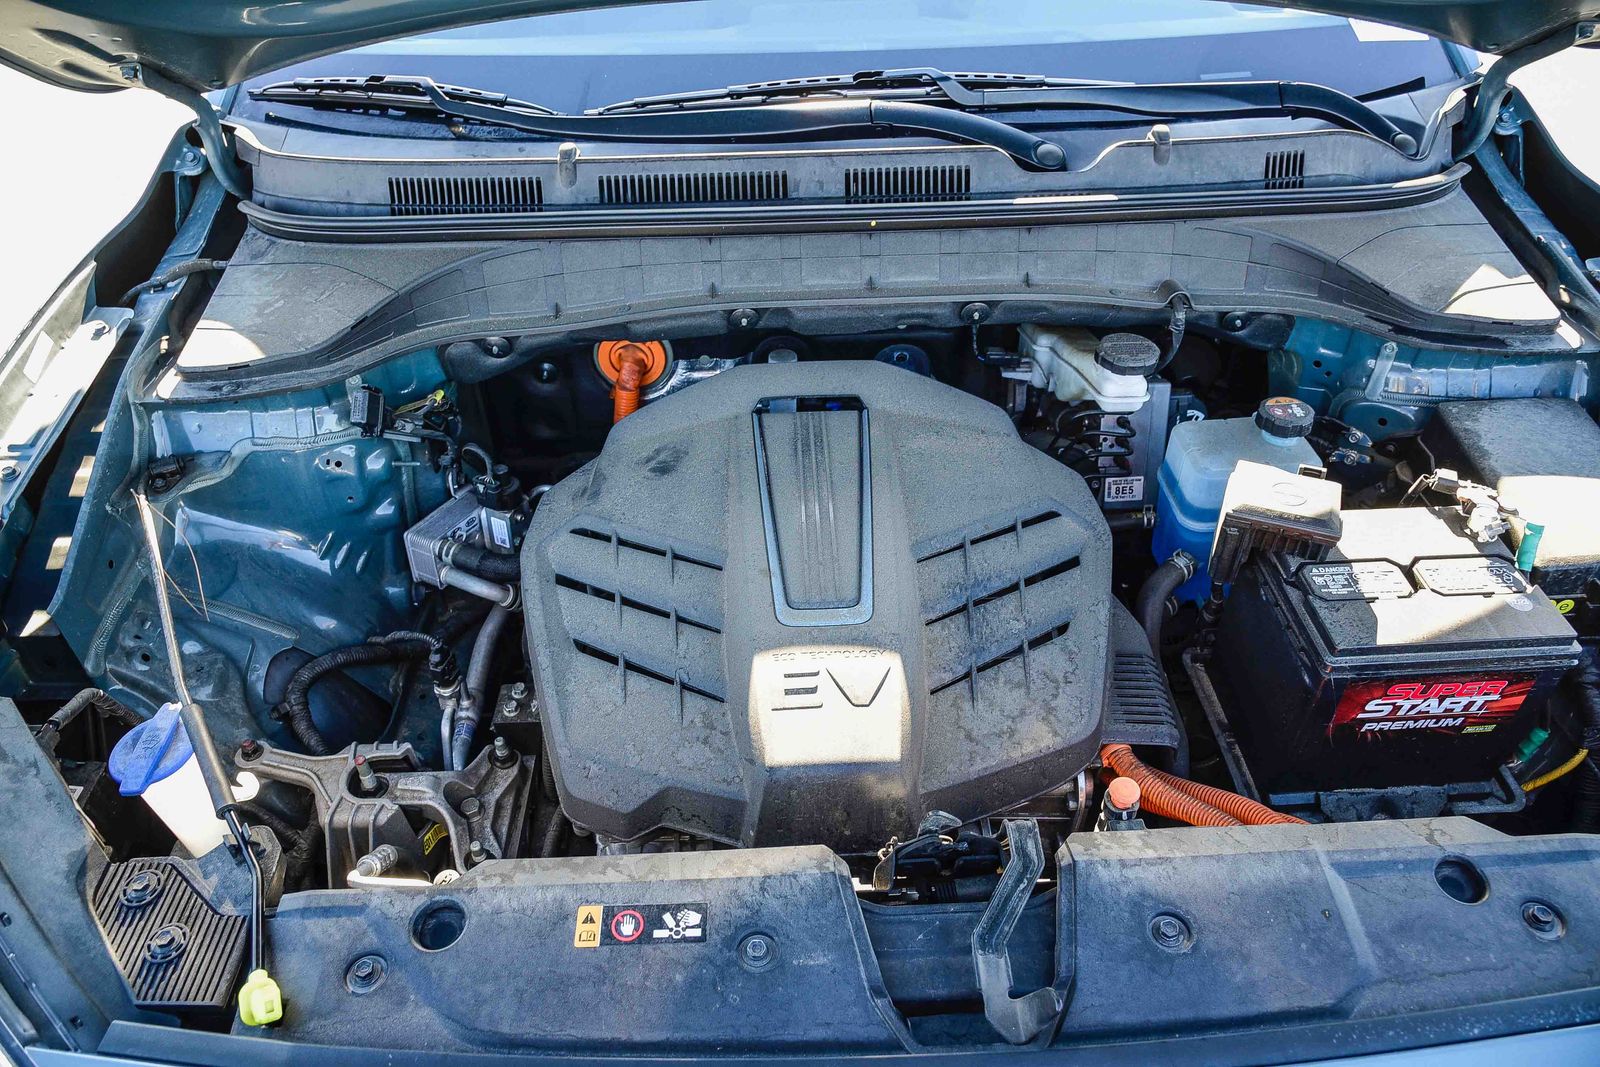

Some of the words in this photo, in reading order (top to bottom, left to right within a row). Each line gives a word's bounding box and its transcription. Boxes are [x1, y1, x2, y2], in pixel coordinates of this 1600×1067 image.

[1115, 486, 1134, 496] 8E5
[770, 666, 892, 711] EV
[1381, 681, 1508, 701] SUPER
[1356, 693, 1502, 719] START
[1360, 717, 1465, 732] PREMIUM
